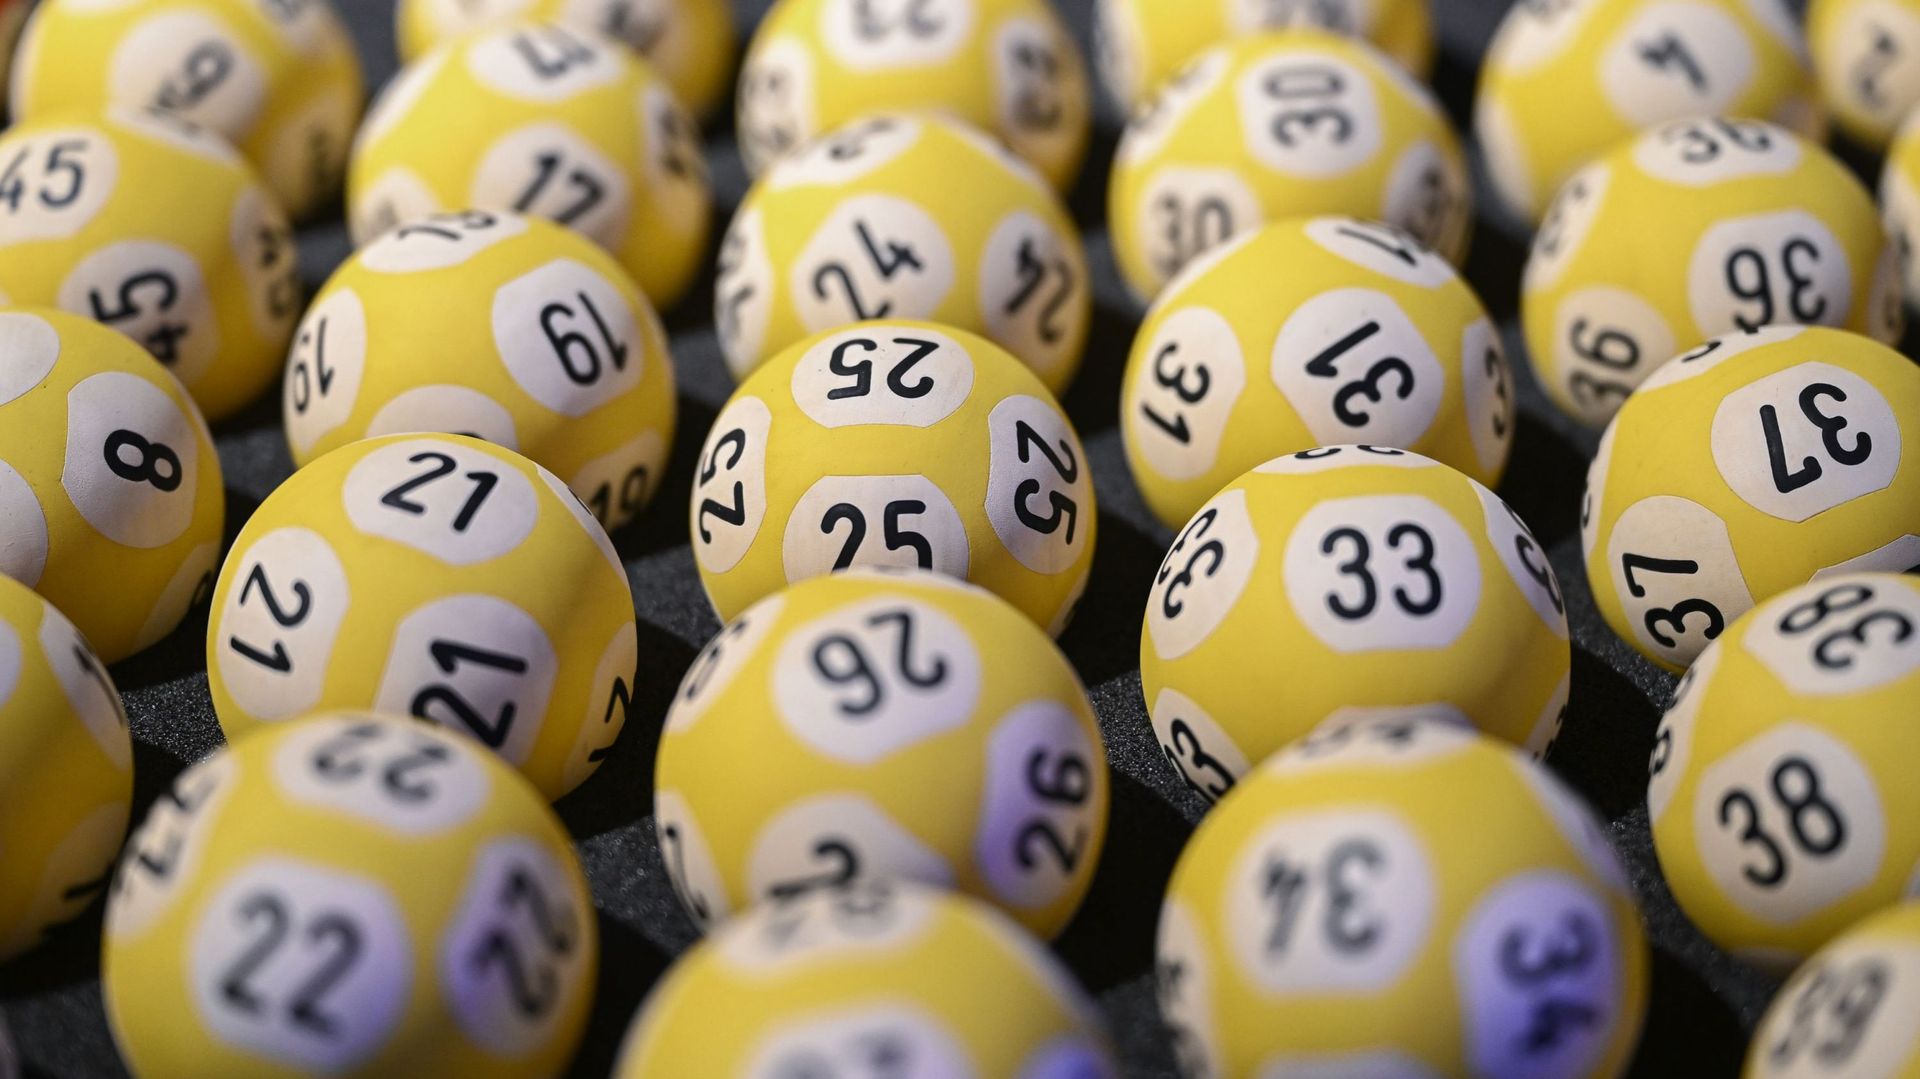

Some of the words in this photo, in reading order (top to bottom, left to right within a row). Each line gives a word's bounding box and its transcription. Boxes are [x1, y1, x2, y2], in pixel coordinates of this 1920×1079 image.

[1262, 66, 1354, 147] 30
[0, 138, 90, 213] 45
[508, 150, 610, 226] 17
[812, 217, 924, 321] 24
[1006, 236, 1072, 344] 24
[1725, 235, 1830, 330] 36
[541, 288, 630, 387] 19
[826, 337, 940, 401] 25
[1303, 318, 1416, 429] 31
[1140, 341, 1212, 448] 31
[1758, 381, 1874, 495] 37
[103, 428, 183, 493] 8
[379, 450, 500, 533] 21
[699, 426, 746, 546] 25
[1013, 418, 1079, 547] 25
[820, 499, 934, 573] 25
[1156, 507, 1226, 620] 33
[1318, 520, 1443, 621] 33
[228, 560, 313, 675] 21
[1620, 551, 1726, 650] 37
[1776, 582, 1915, 671] 38
[407, 636, 530, 750] 21
[810, 606, 949, 718] 26
[1014, 742, 1094, 877] 26
[1714, 752, 1849, 891] 38
[1258, 833, 1392, 960] 34
[213, 888, 366, 1042] 22
